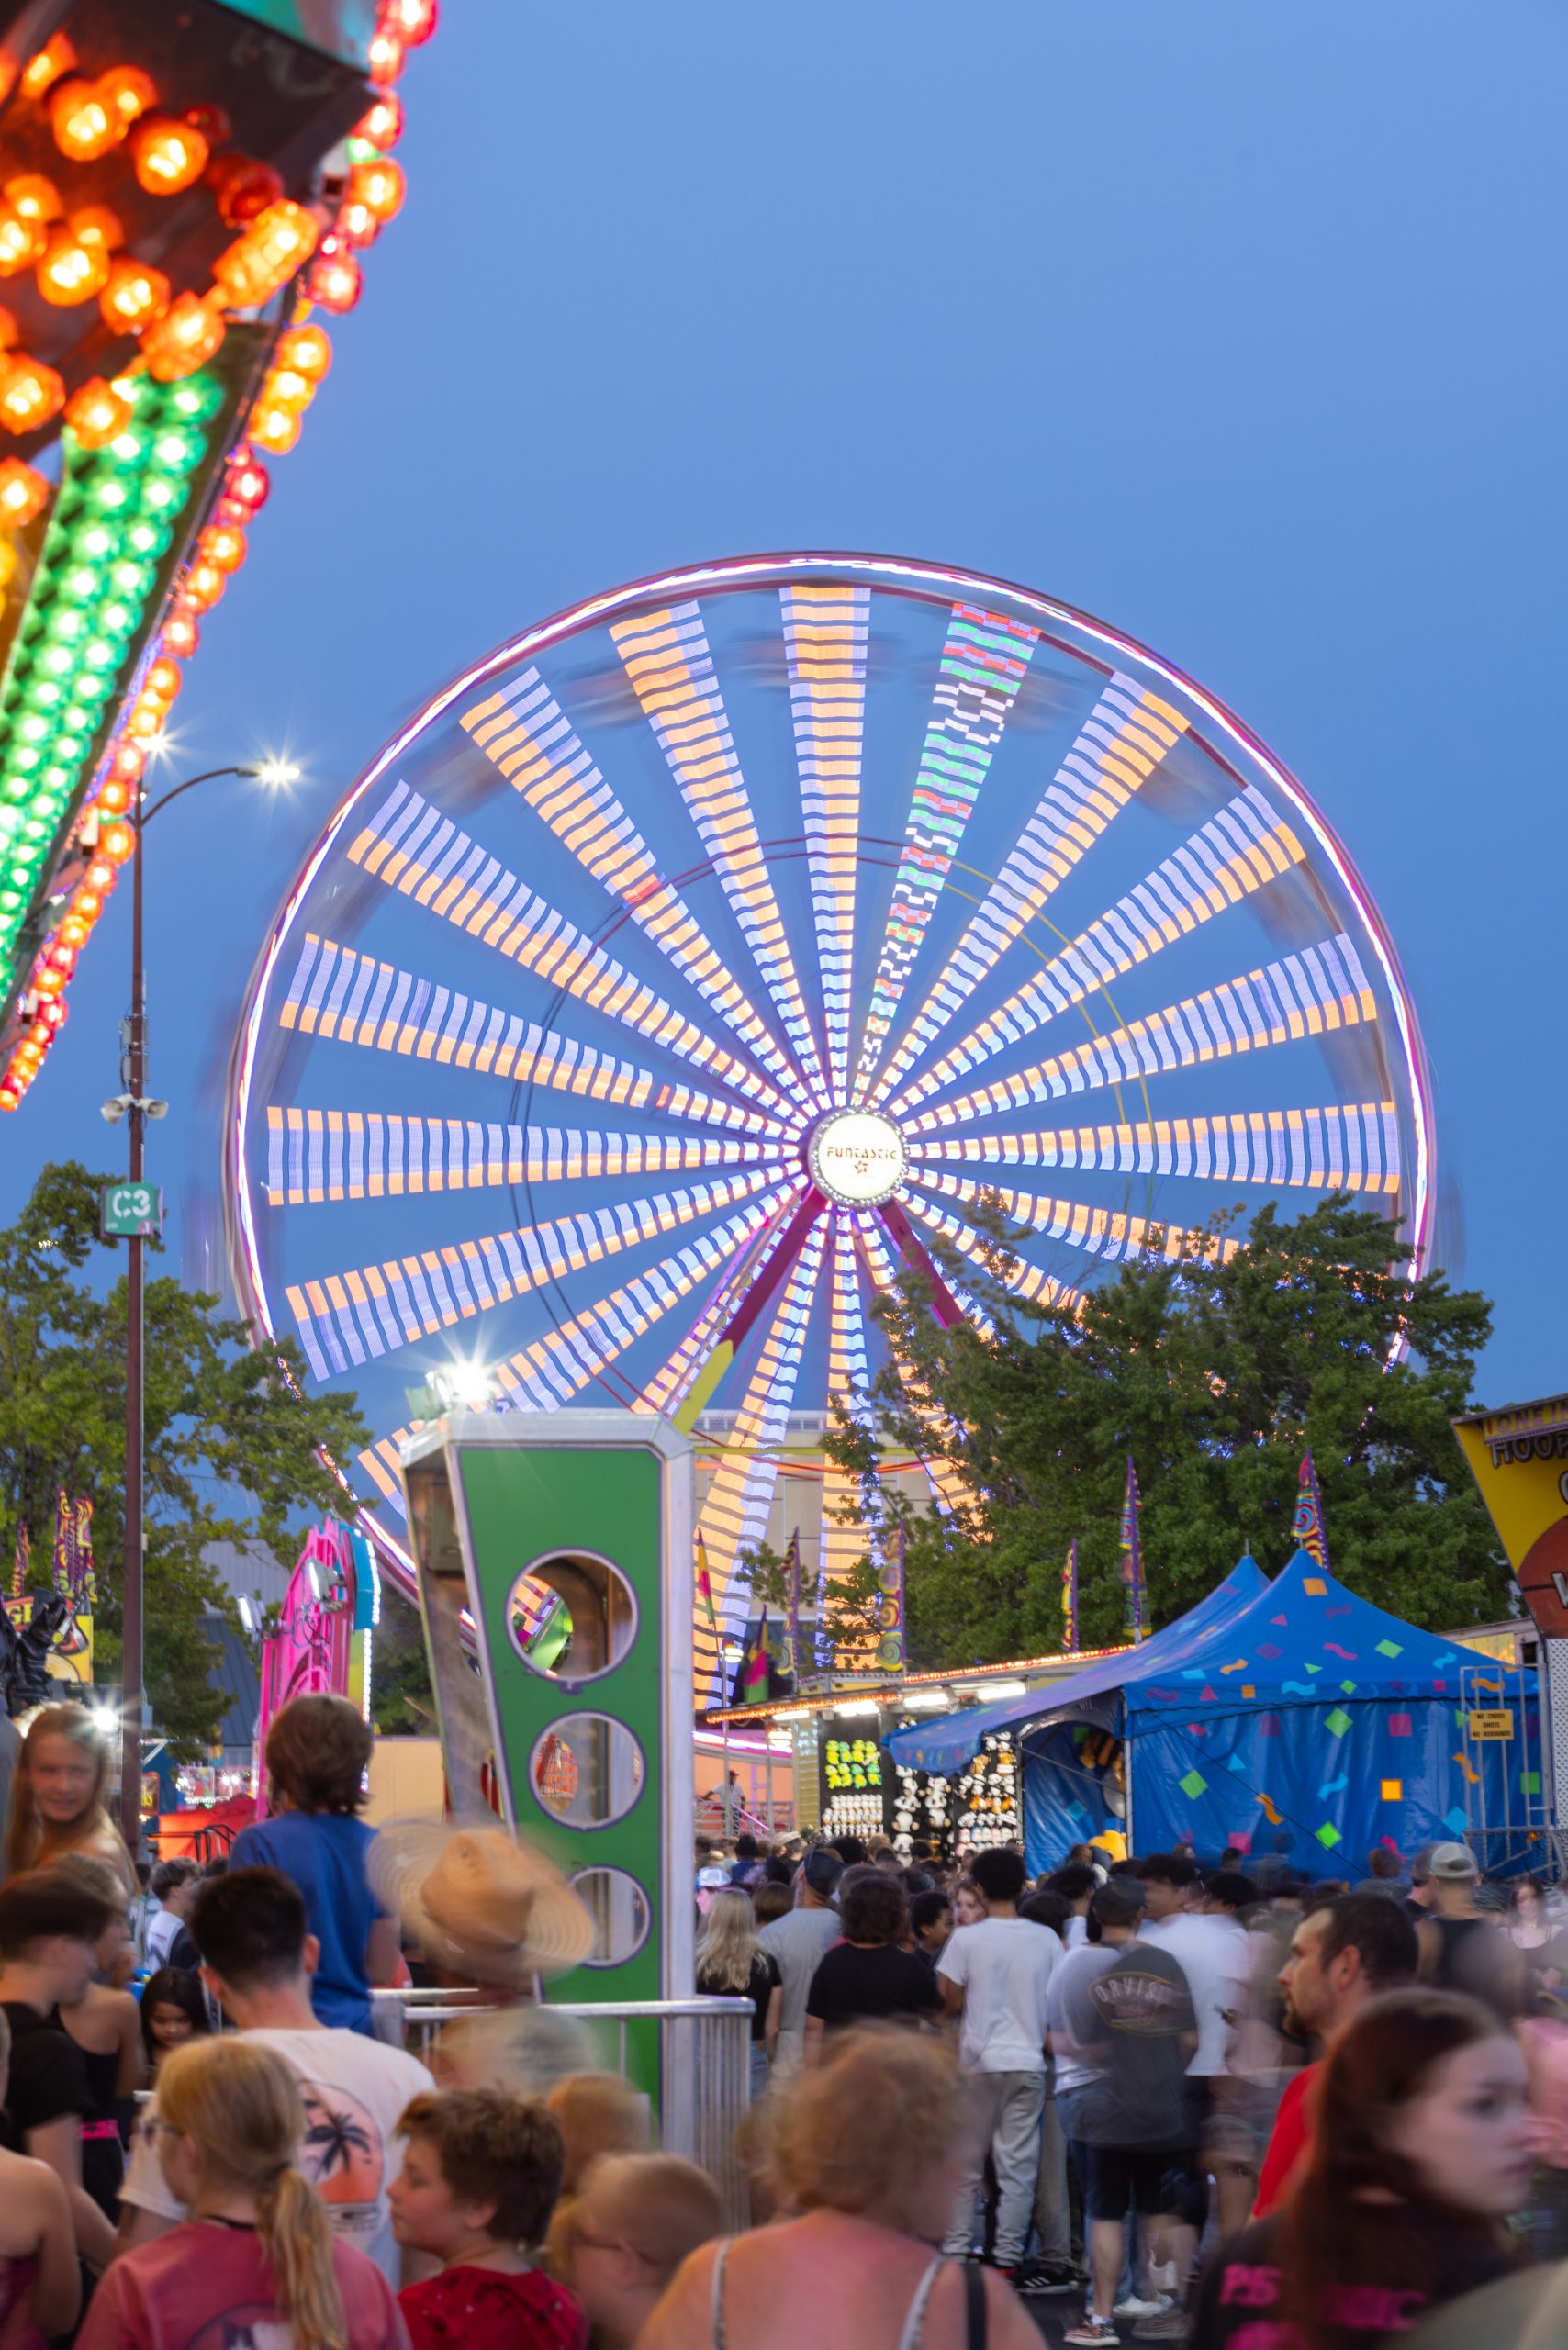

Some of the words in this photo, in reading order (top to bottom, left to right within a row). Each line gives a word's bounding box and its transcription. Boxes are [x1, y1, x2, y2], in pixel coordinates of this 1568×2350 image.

[827, 1147, 897, 1160] FUNTASTIC
[112, 1189, 151, 1219] C3
[1497, 1405, 1544, 1433] ONE
[1094, 1976, 1161, 2003] ORVIS
